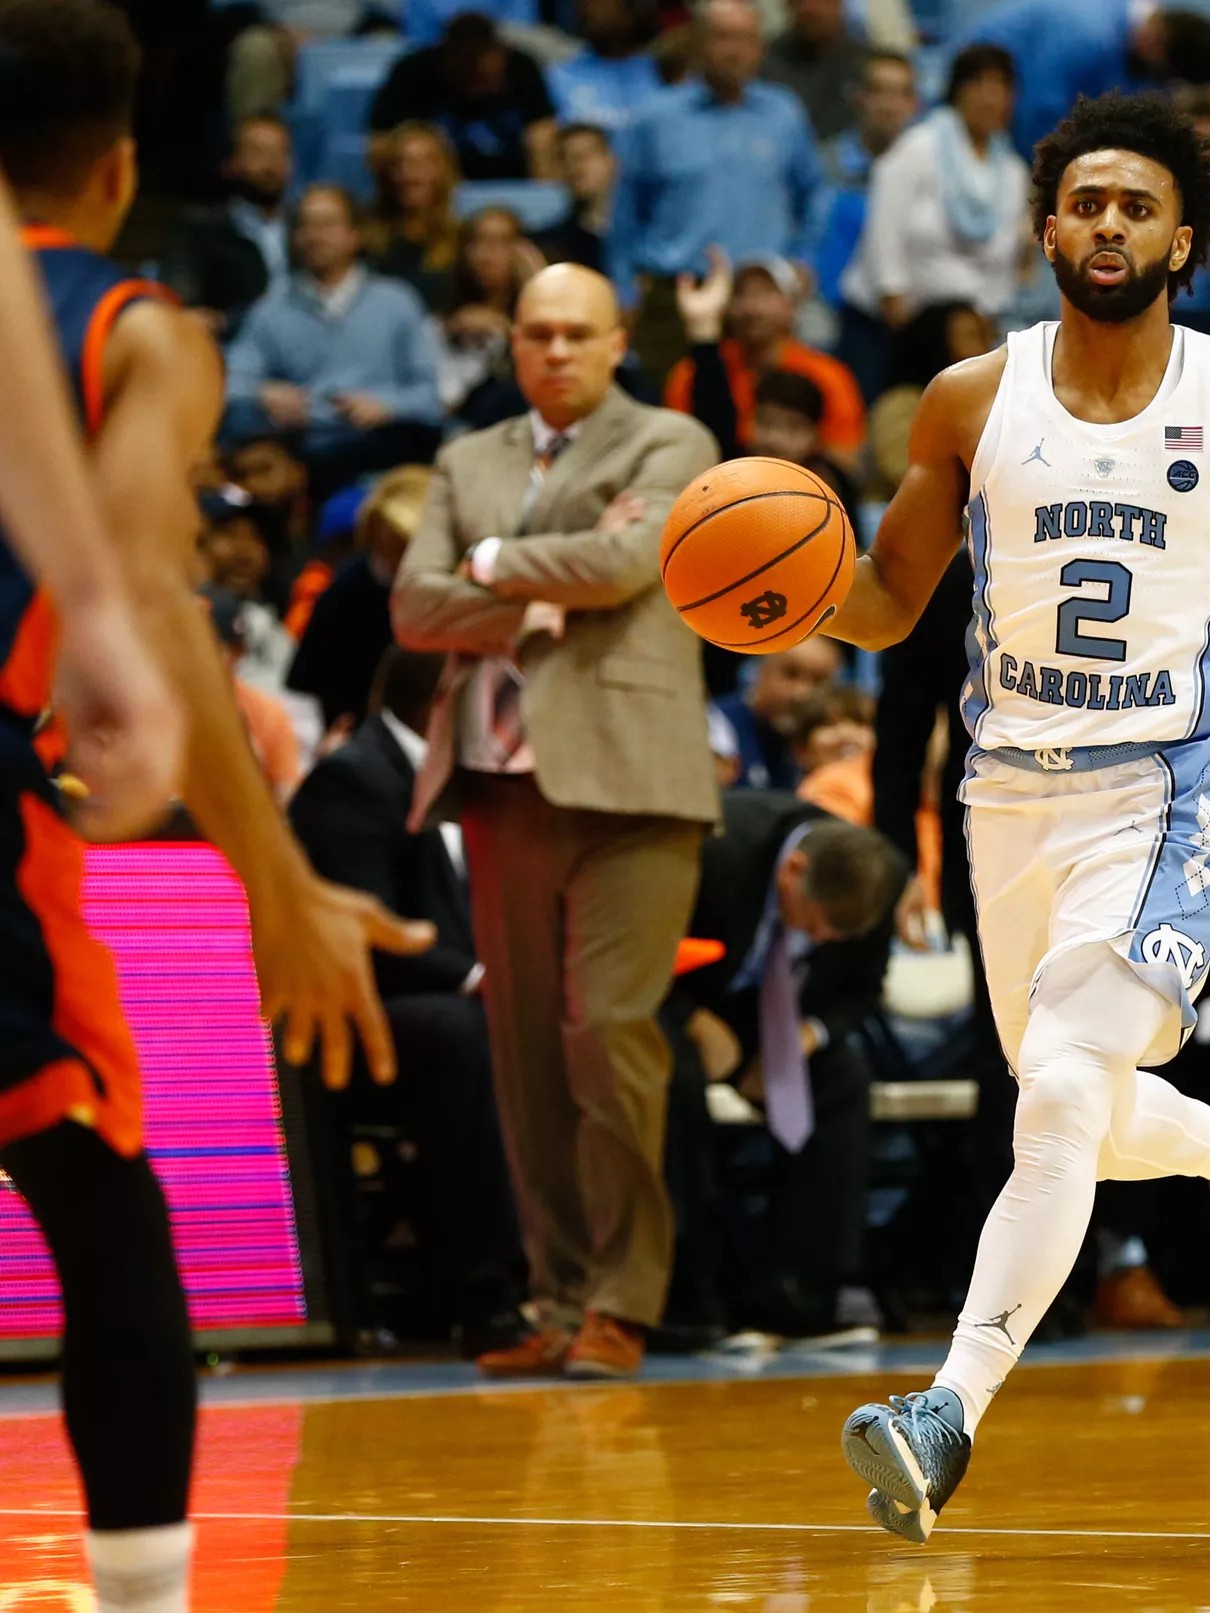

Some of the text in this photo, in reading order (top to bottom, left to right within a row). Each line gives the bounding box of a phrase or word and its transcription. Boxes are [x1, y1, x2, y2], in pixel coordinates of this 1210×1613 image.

[1035, 501, 1167, 549] NORTH
[1056, 558, 1132, 661] 2
[1000, 654, 1175, 710] CAROLINA
